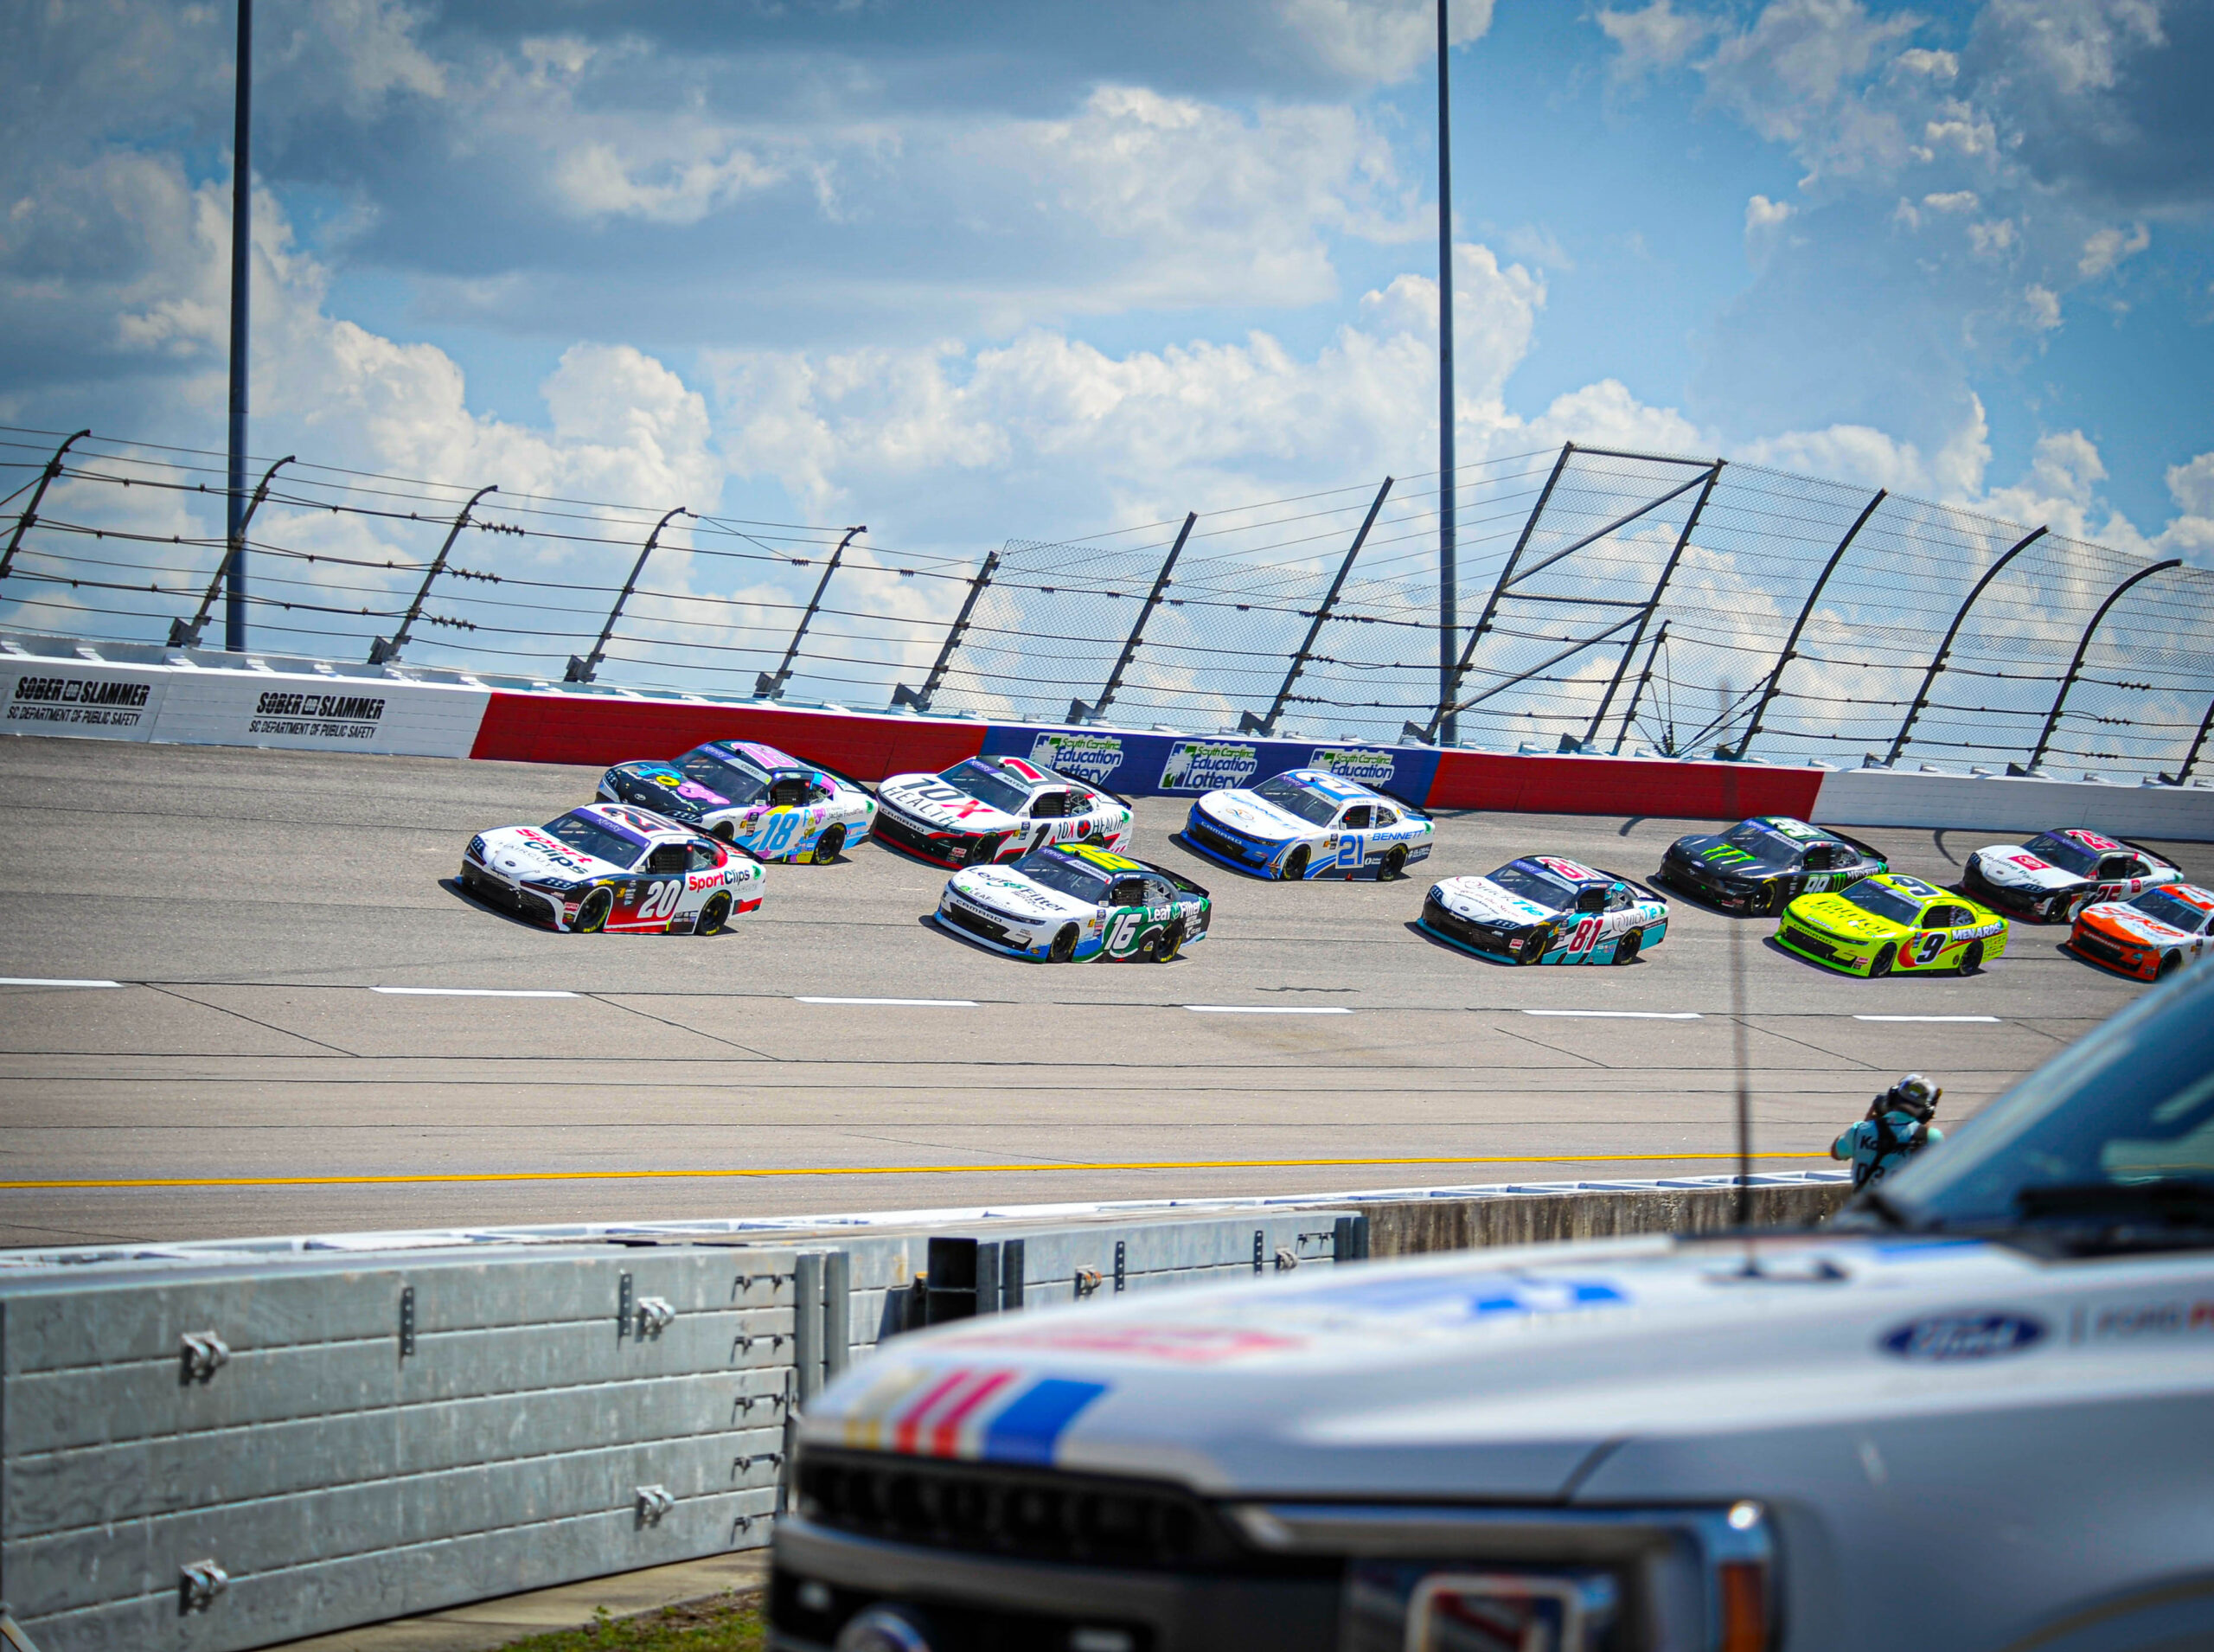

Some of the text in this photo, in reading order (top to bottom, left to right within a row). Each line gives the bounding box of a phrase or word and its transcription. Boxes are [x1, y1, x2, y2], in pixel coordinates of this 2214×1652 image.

[15, 676, 65, 701] SOBER
[80, 681, 150, 707] SLAMMER
[7, 705, 142, 726] SC DEPARTMENT OF PUBLIC SAFETY
[256, 692, 304, 715] SOBER
[318, 695, 386, 720] SLAMMER
[249, 720, 377, 739] SC DEPARTMENT OF PUBLIC SAFETY
[1062, 738, 1121, 750] South Carolina
[1198, 746, 1255, 759] South Carolina
[970, 759, 993, 772] xfinity
[1055, 746, 1122, 765] Education
[1191, 753, 1257, 772] Education
[1336, 753, 1392, 765] South Carolina
[740, 763, 760, 776] CREED
[1183, 770, 1243, 789] Lottery
[1330, 761, 1393, 779] Education
[1003, 777, 1025, 790] MAYER
[881, 786, 960, 828] HEALTH
[899, 778, 996, 819] 10X
[596, 817, 624, 832] xfinity
[881, 808, 925, 833] CAMARO
[1057, 821, 1075, 840] 10X
[1091, 814, 1124, 834] HEALTH
[758, 813, 801, 851] 18
[1026, 823, 1052, 857] 1
[1200, 821, 1243, 845] CAMARO
[1372, 829, 1425, 842] BENNETT
[515, 829, 592, 863] Sport
[1042, 848, 1066, 860] xfinity
[1338, 835, 1365, 866] 21
[523, 842, 589, 874] Clips
[1979, 852, 2043, 885] Genuine Parts
[1551, 875, 1568, 887] SMITH
[637, 880, 681, 919] 20
[2093, 883, 2127, 904] 25
[956, 899, 1003, 923] CAMARO
[1147, 901, 1200, 922] Leaf Filter
[1104, 913, 1142, 951] 16
[1567, 918, 1604, 953] 81
[1793, 924, 1833, 944] CAMARO
[1951, 922, 2002, 941] MENARDS
[2083, 931, 2121, 951] CAMARO
[1915, 932, 1947, 964] 9
